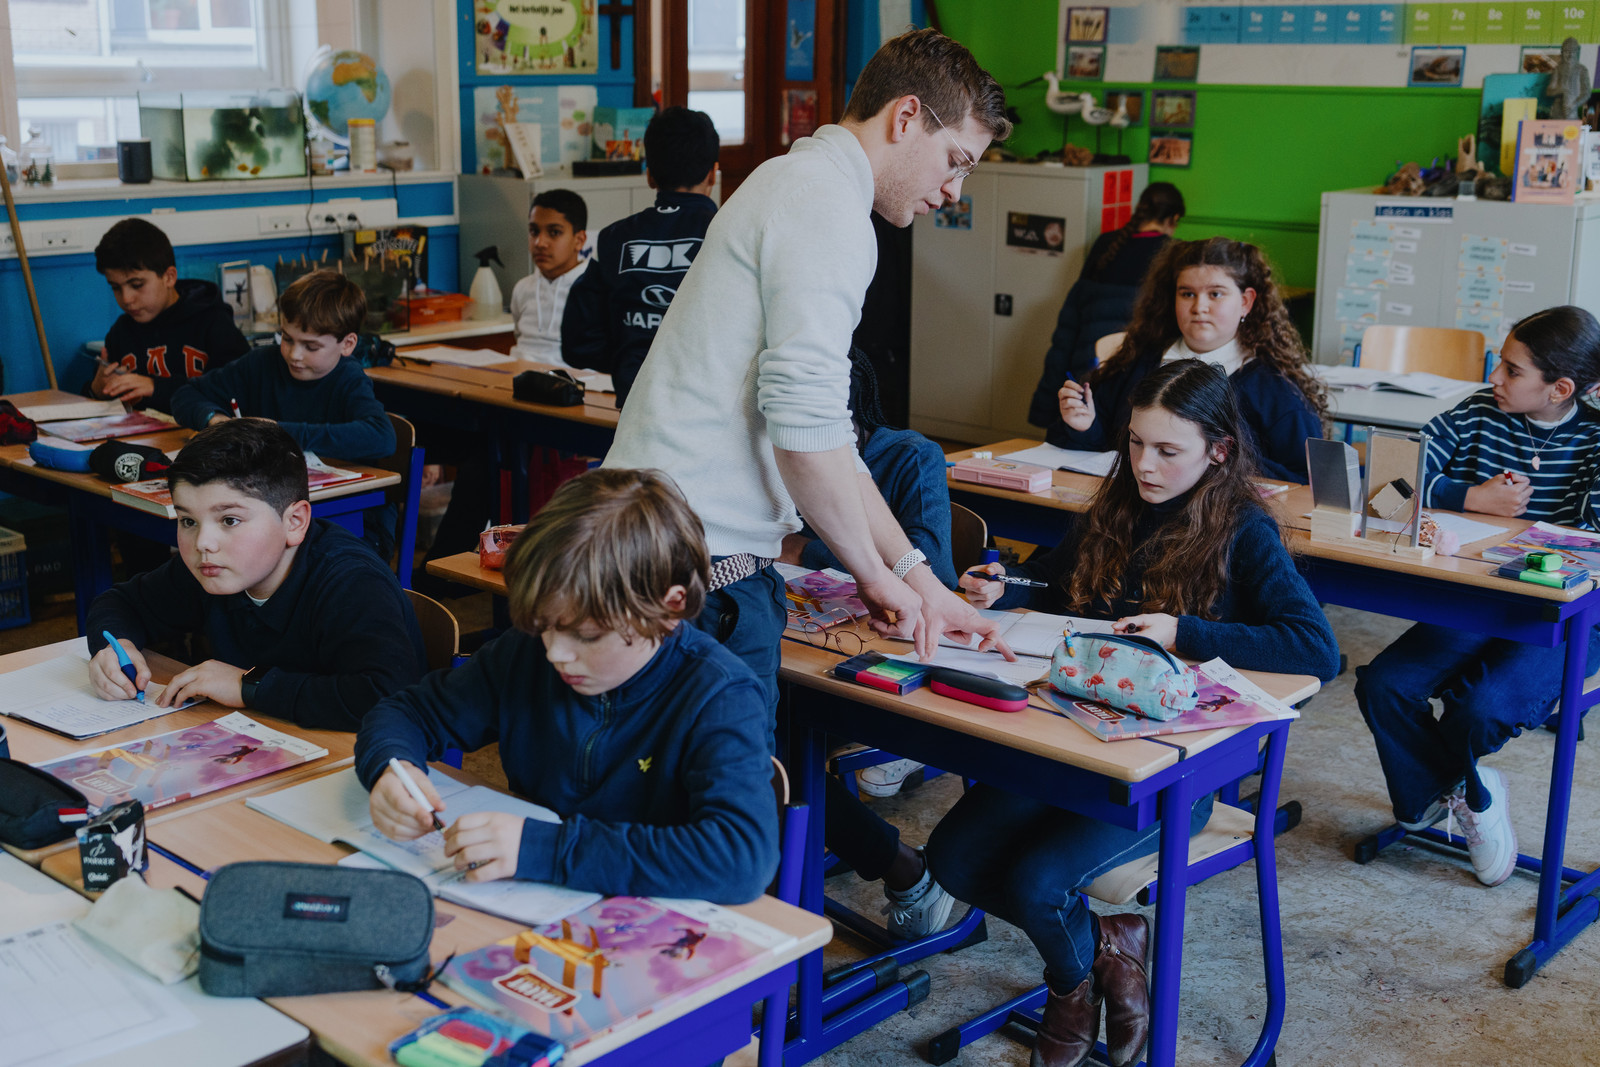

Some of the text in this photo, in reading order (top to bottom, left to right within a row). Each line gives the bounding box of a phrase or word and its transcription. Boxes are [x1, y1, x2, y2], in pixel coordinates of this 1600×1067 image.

[1251, 11, 1263, 22] 1e
[1281, 11, 1295, 23] 2e
[1314, 11, 1328, 22] 3e
[1346, 11, 1360, 22] 4e
[1380, 10, 1394, 22] 5e
[1415, 10, 1430, 21] 6e
[1451, 9, 1466, 20] 7e
[1488, 8, 1503, 20] 8e
[1526, 8, 1541, 19] 9e
[1563, 7, 1585, 19] 10e
[83, 856, 116, 866] PARKER
